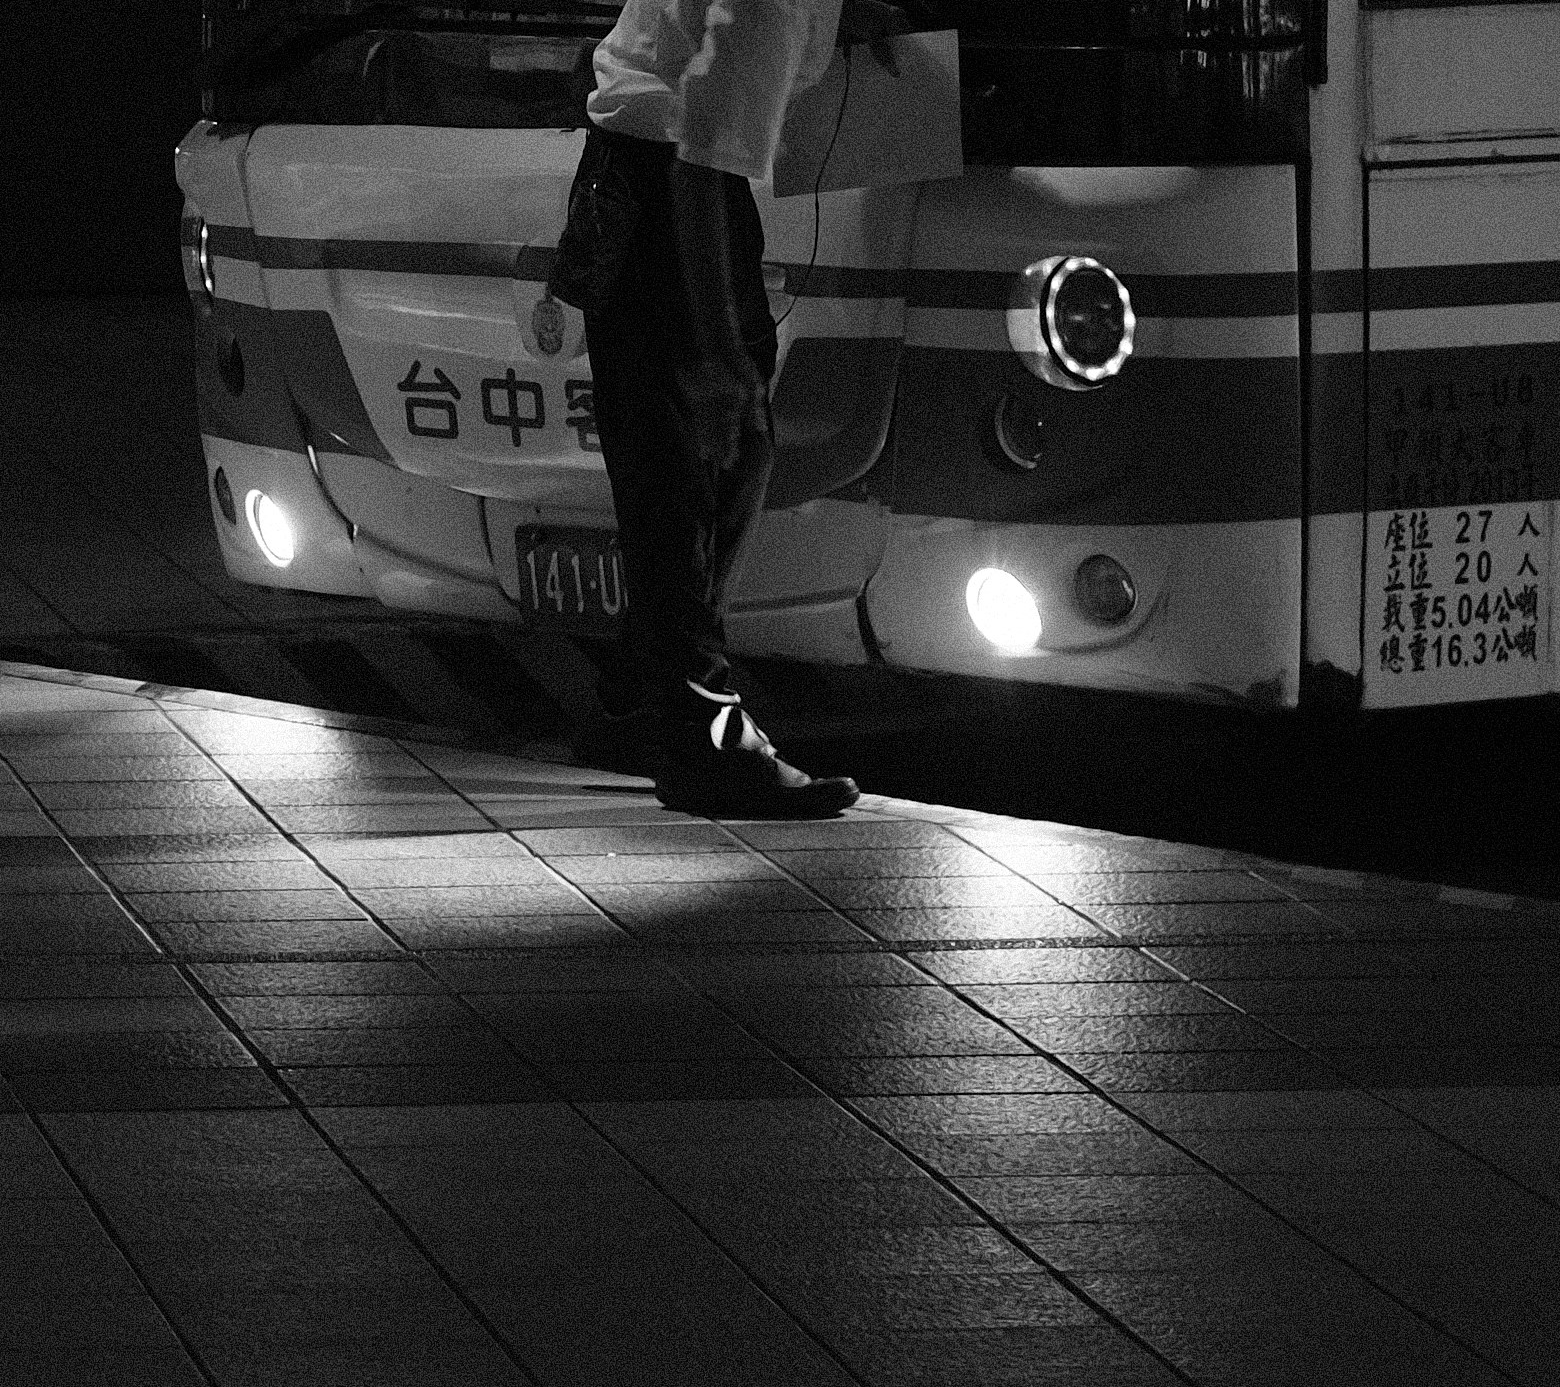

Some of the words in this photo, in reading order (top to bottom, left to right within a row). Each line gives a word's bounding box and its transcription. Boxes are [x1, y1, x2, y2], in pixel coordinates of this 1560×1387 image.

[1384, 510, 1433, 552] 座位
[1455, 509, 1493, 544] 27
[1517, 512, 1541, 538] 人
[1383, 551, 1433, 591] 立位
[1454, 550, 1492, 585] 20
[1516, 552, 1539, 577] 人
